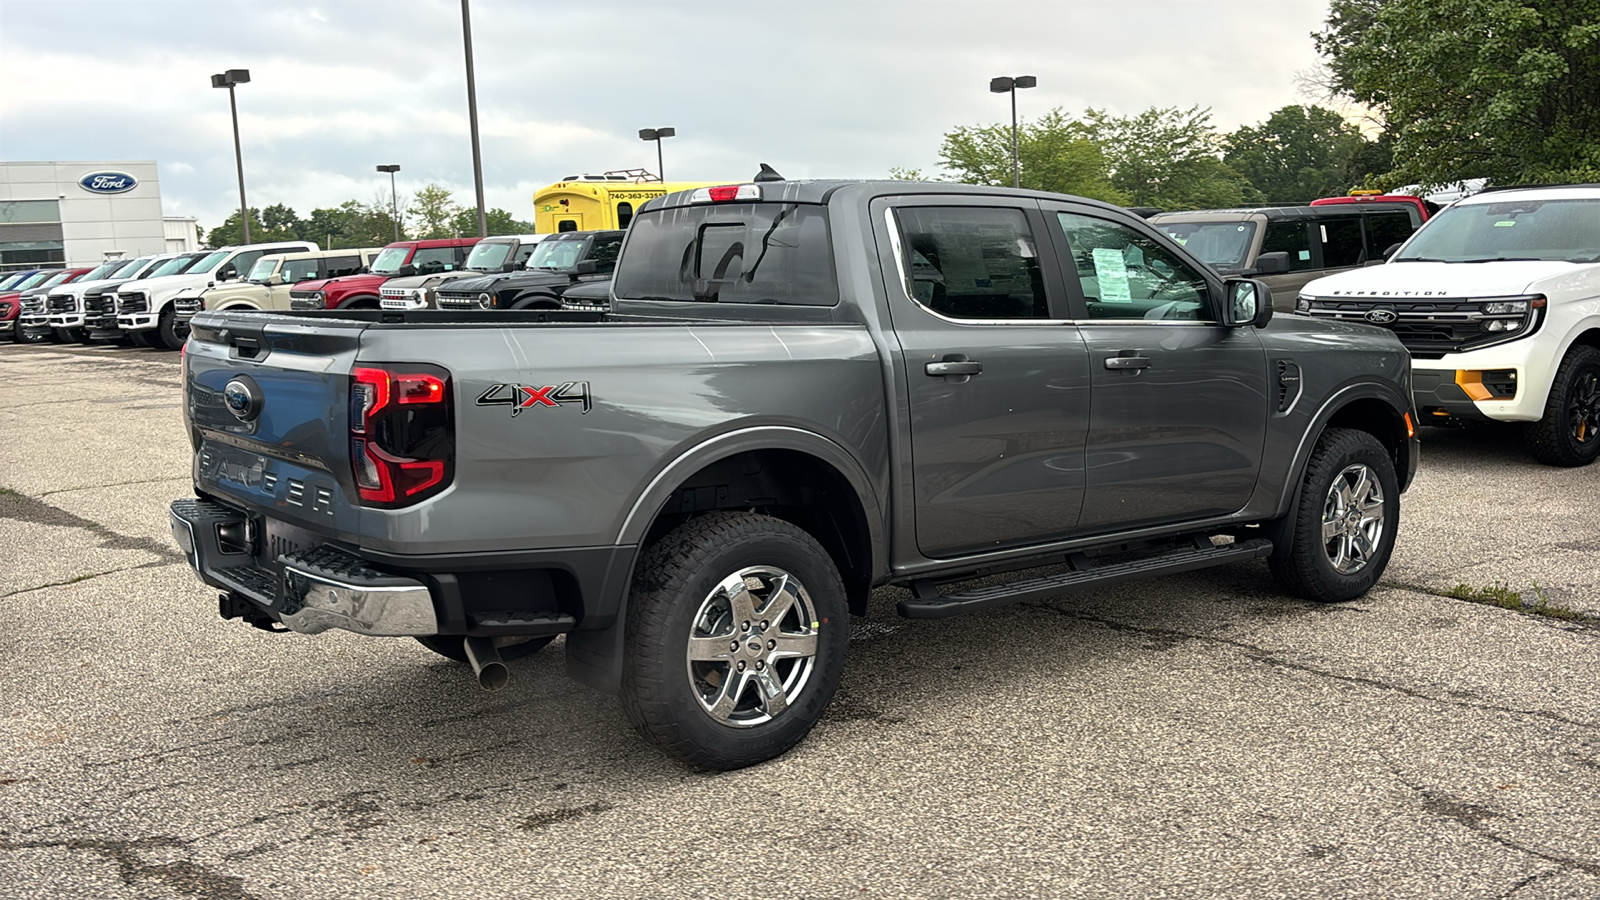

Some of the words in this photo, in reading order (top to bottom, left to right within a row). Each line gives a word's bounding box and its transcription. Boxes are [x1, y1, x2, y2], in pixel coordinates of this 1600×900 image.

[91, 175, 126, 189] Ford
[1370, 310, 1391, 321] Ford
[200, 453, 334, 516] RANGER
